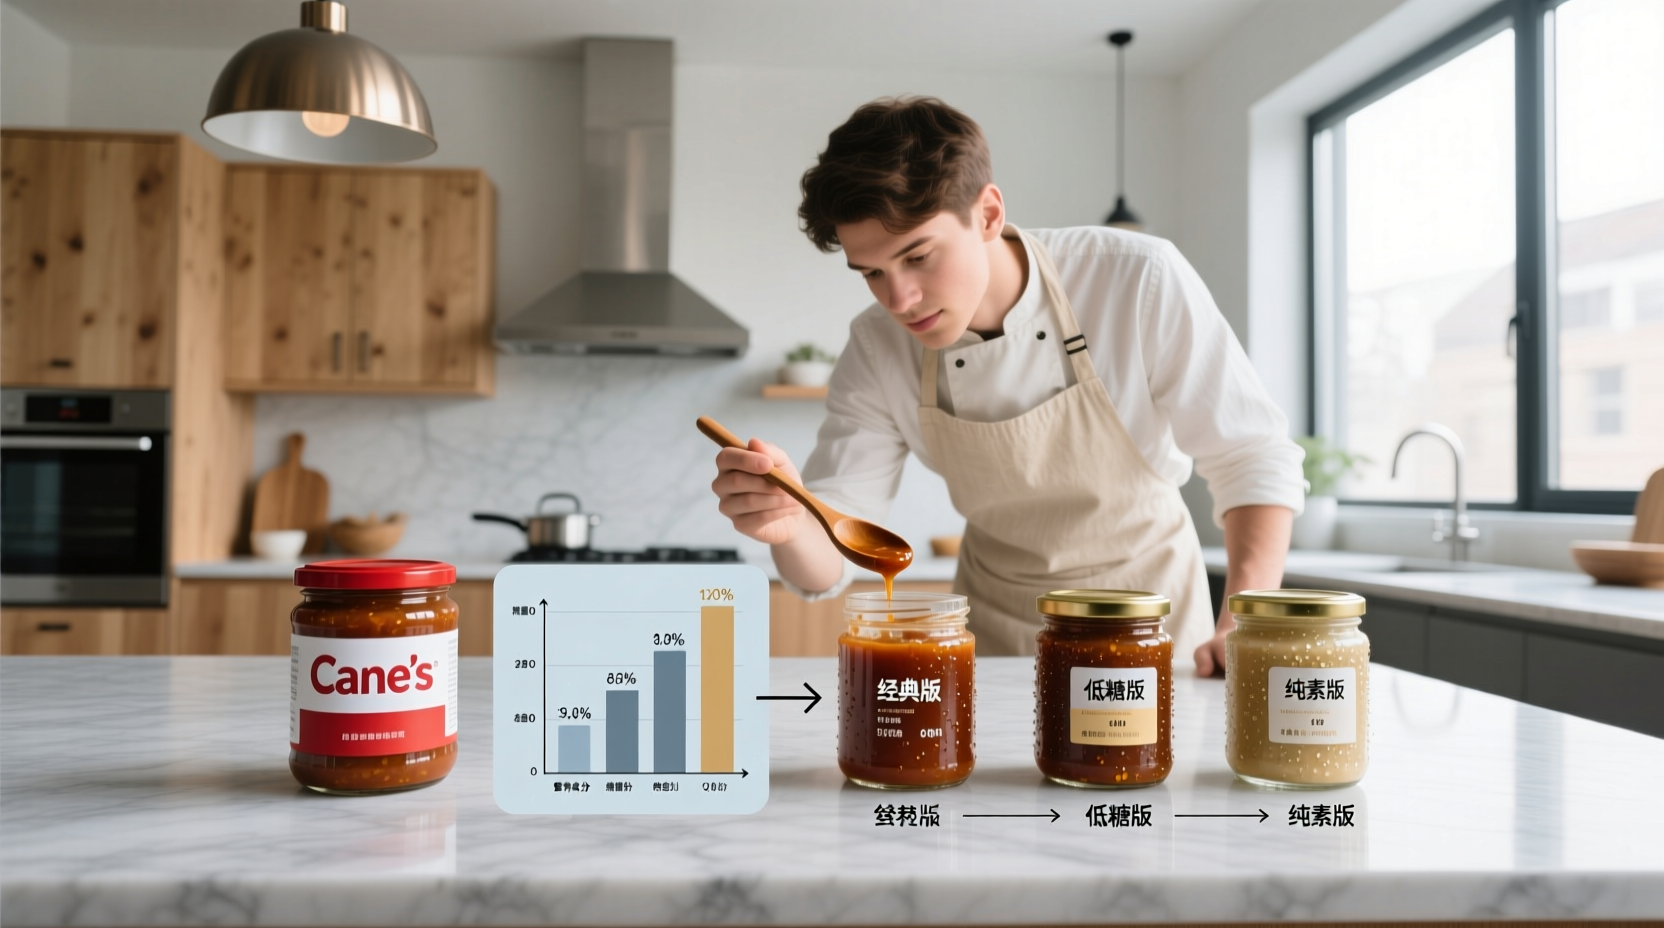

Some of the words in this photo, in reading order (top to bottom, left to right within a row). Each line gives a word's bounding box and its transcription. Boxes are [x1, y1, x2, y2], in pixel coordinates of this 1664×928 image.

[310, 654, 434, 695] Cane's
[877, 677, 942, 703] 经典版
[1083, 678, 1145, 702] 低糖版
[1284, 677, 1345, 701] 纯素版
